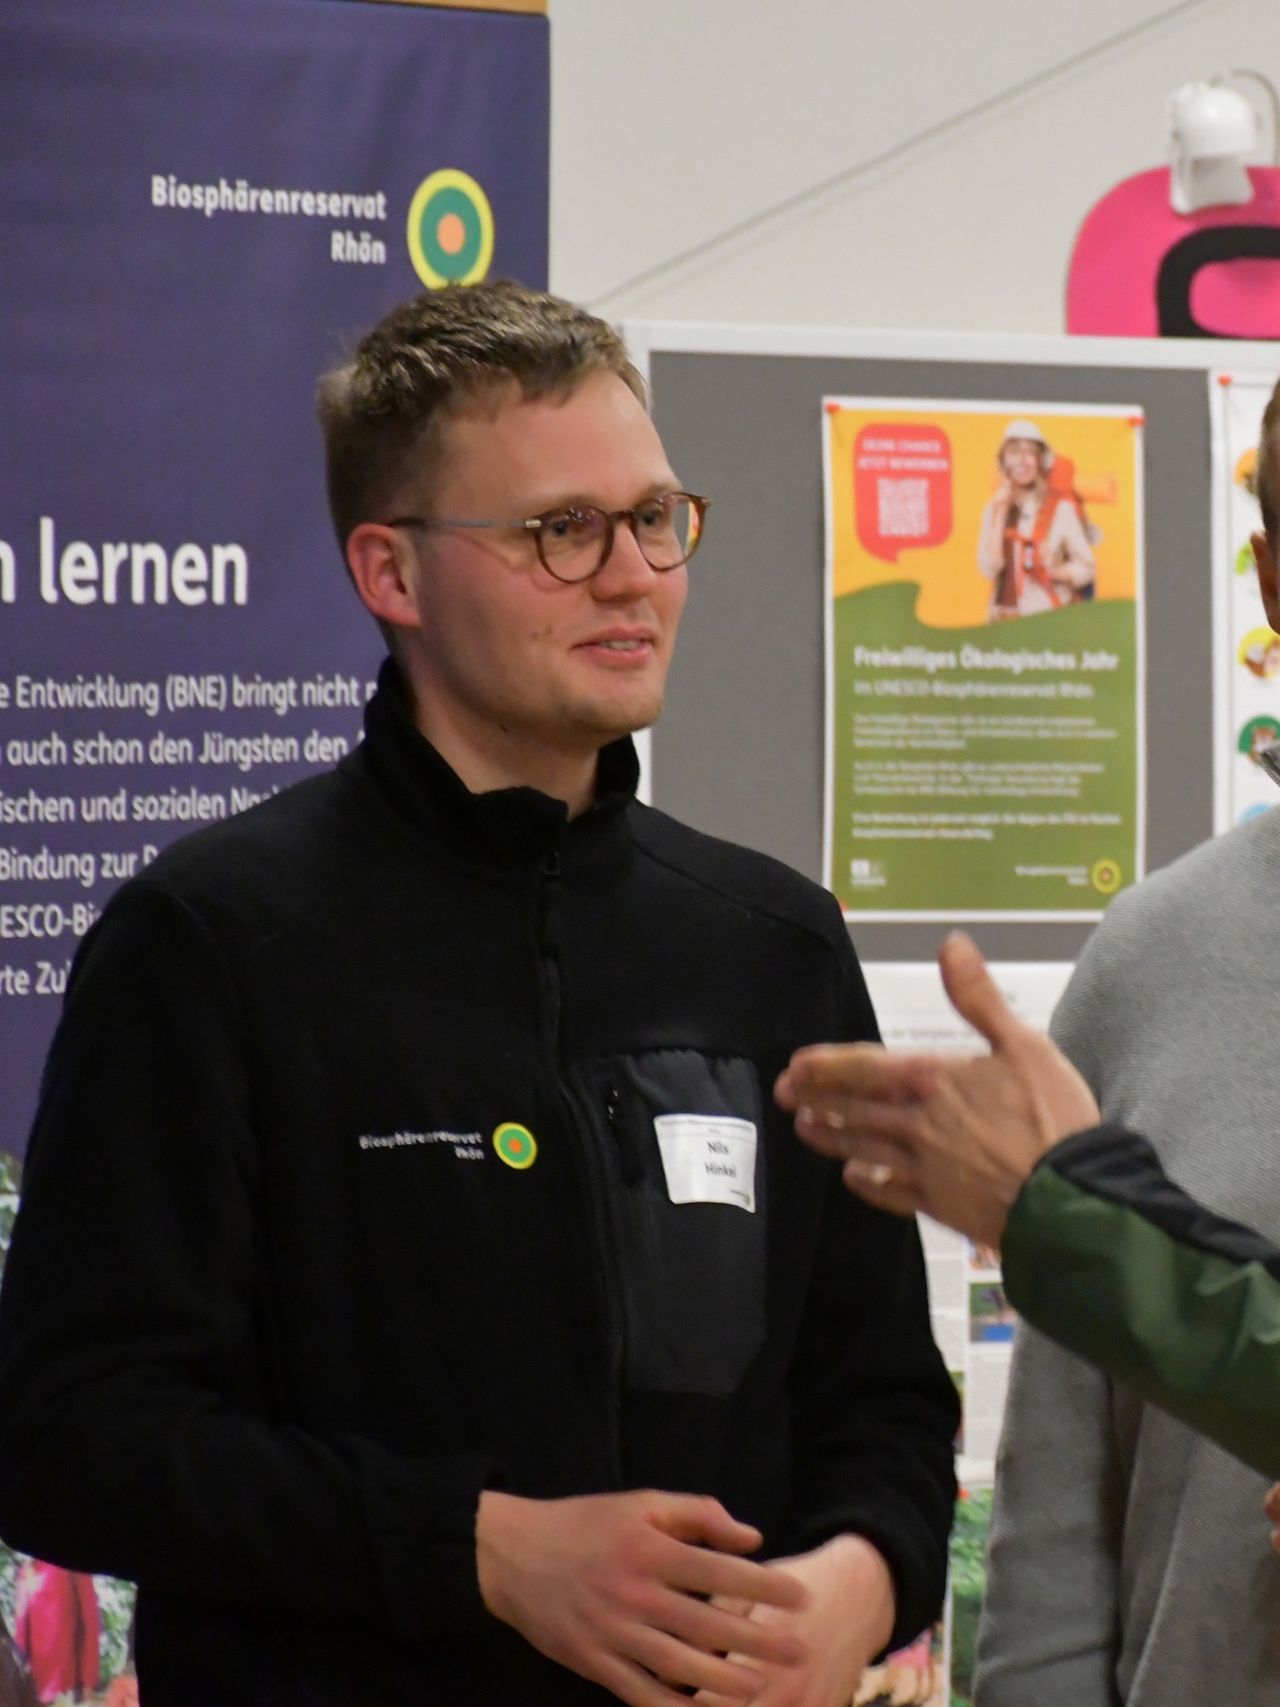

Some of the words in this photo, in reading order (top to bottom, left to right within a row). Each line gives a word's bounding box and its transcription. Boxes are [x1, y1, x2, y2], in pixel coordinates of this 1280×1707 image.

[151, 174, 387, 220] Biosphärenreservat
[331, 230, 387, 264] Rhön
[39, 515, 248, 606] lernen
[853, 644, 957, 674] Freiwilliges
[959, 642, 1077, 674] Ökologisches
[1080, 648, 1119, 672] Jahr
[15, 674, 160, 717] Entwicklung
[165, 673, 228, 712] (BNE)
[232, 673, 299, 716] bringt
[302, 673, 361, 707] nicht
[6, 731, 68, 766] auch
[72, 729, 145, 765] schon
[149, 730, 194, 765] den
[198, 731, 300, 772] Jüngsten
[303, 728, 350, 763] den
[80, 788, 127, 822] und
[132, 787, 227, 821] sozialen
[0, 845, 96, 888] Bindung
[100, 852, 138, 878] zur
[0, 901, 103, 938] ESCO-Bi
[35, 959, 72, 995] Zu
[707, 1141, 731, 1156] Nils
